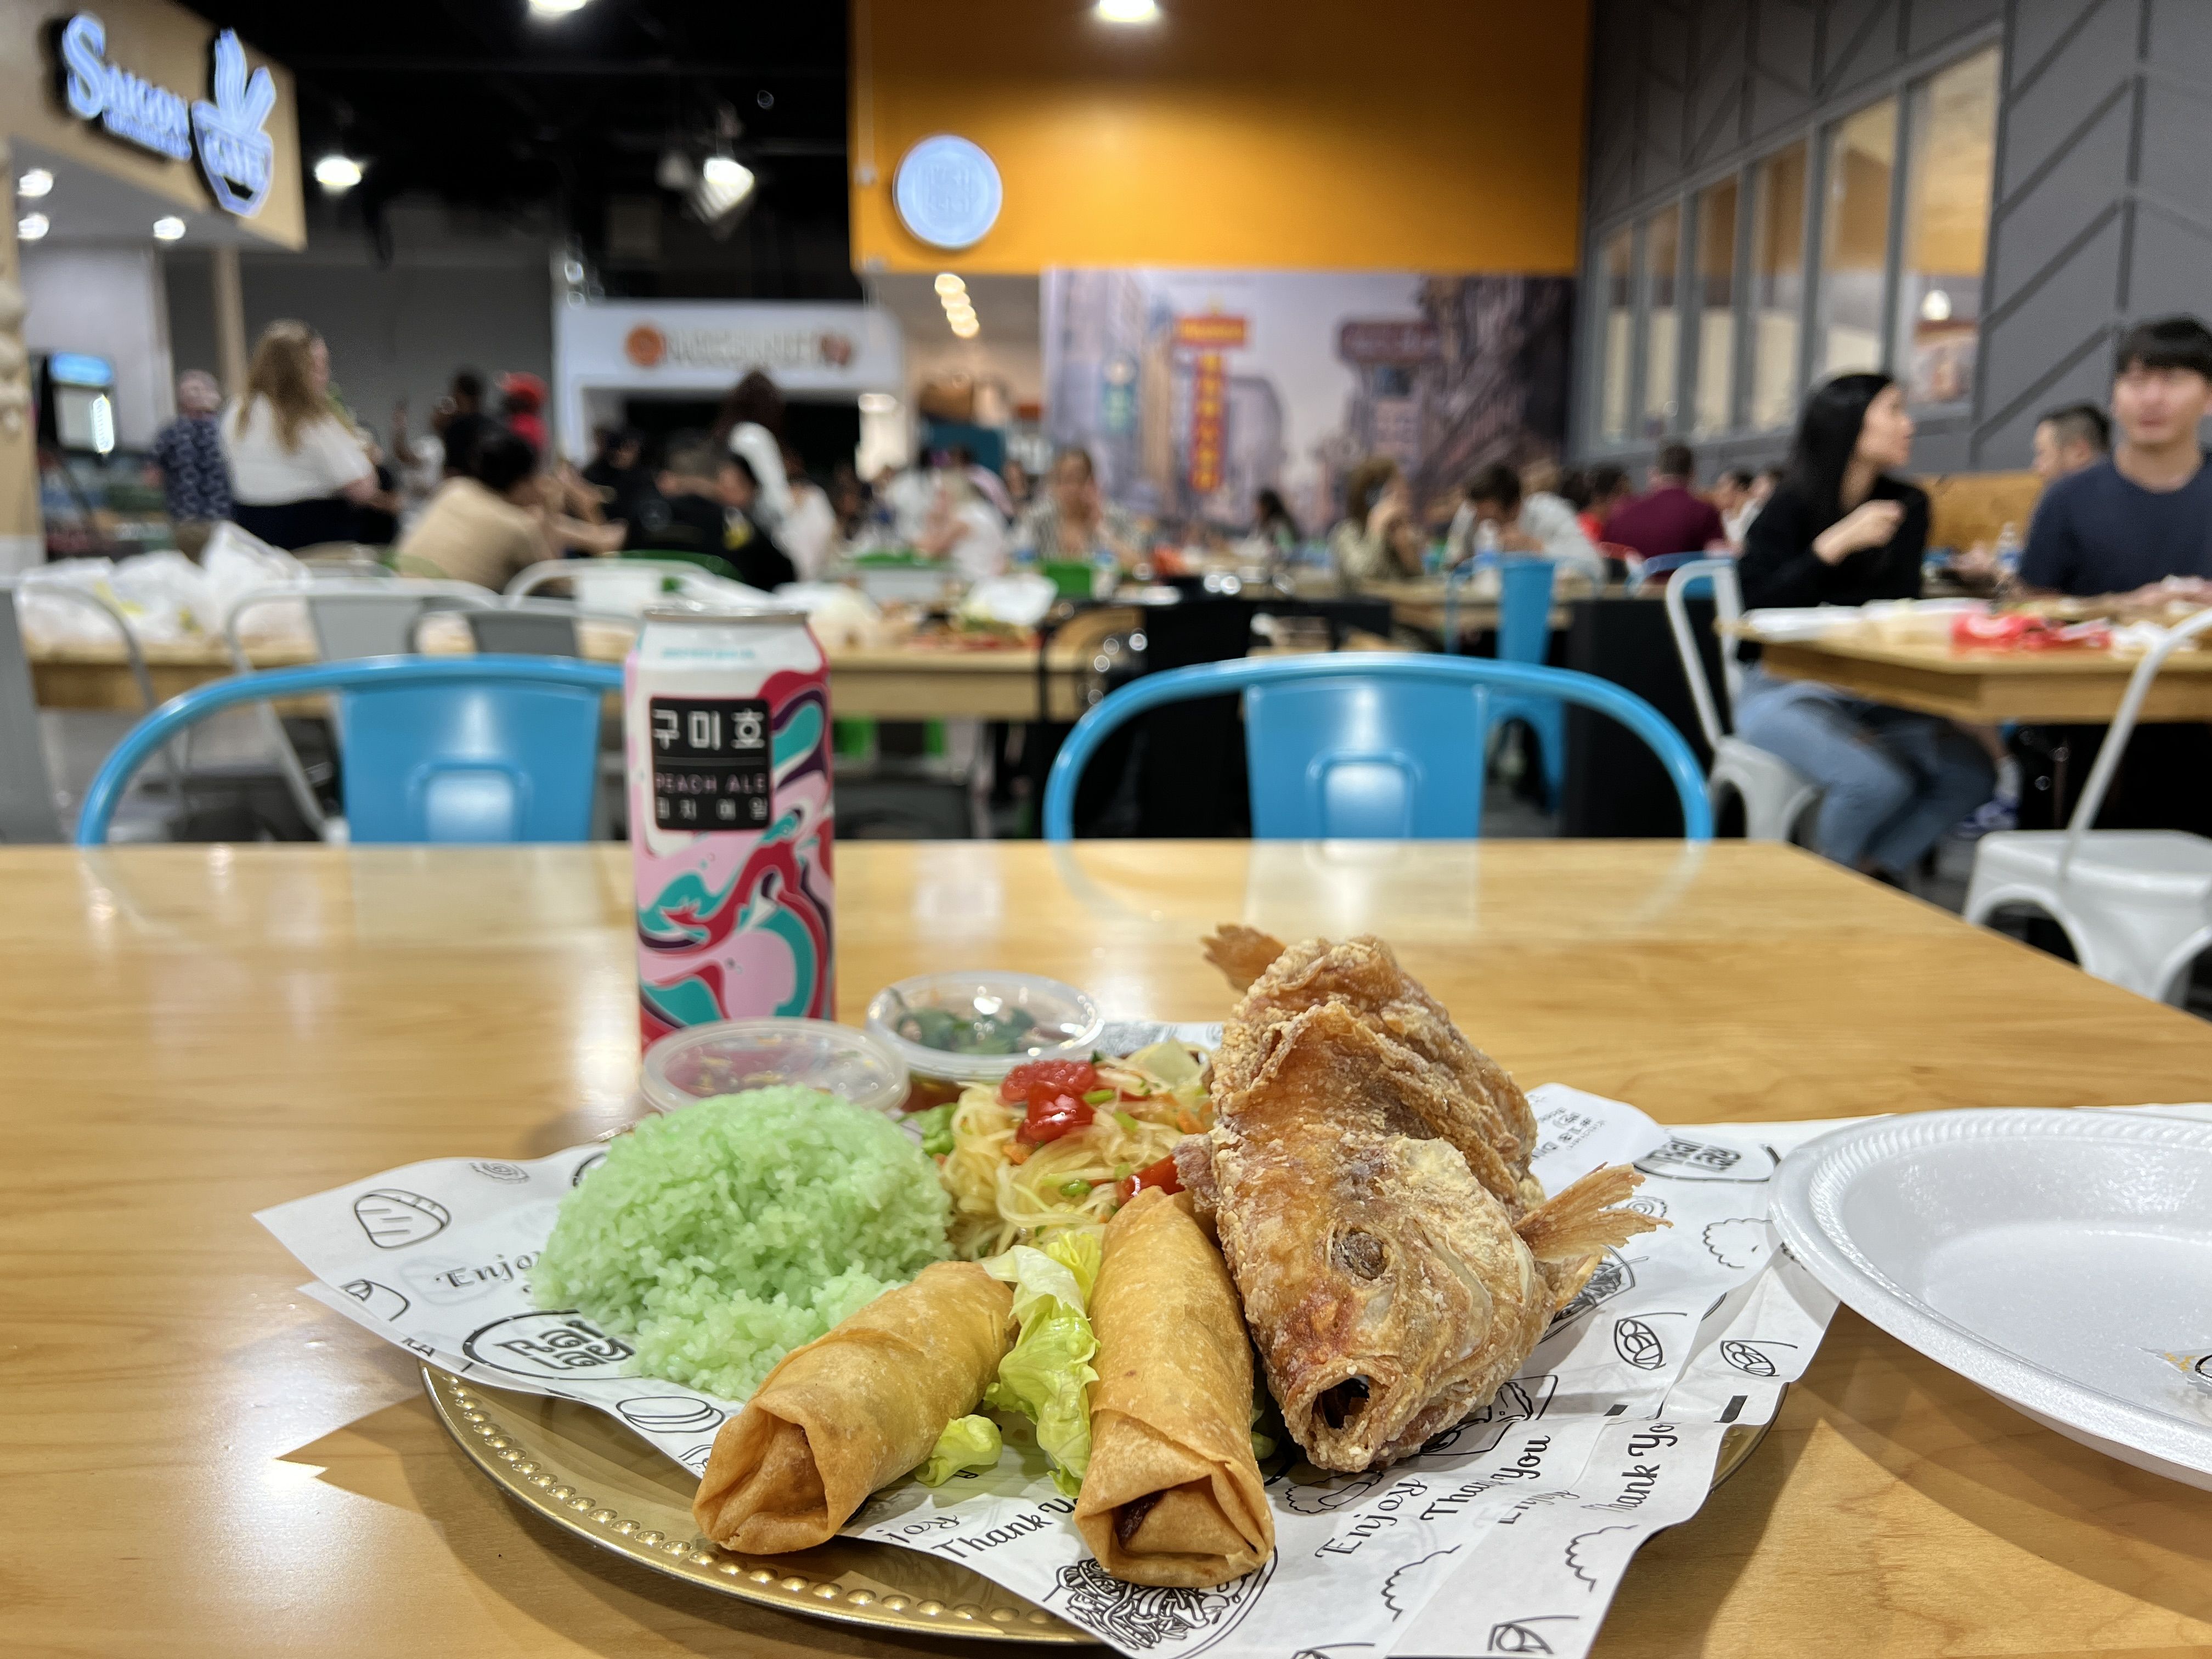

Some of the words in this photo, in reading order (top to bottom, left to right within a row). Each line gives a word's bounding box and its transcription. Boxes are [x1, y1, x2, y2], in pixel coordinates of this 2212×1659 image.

[652, 708, 765, 750] 구미호
[725, 773, 766, 794] ALE
[1419, 1480, 1514, 1520] Thank
[1490, 1435, 1550, 1480] You
[930, 1514, 1053, 1558] Thank
[1315, 1479, 1427, 1558] Enjoy
